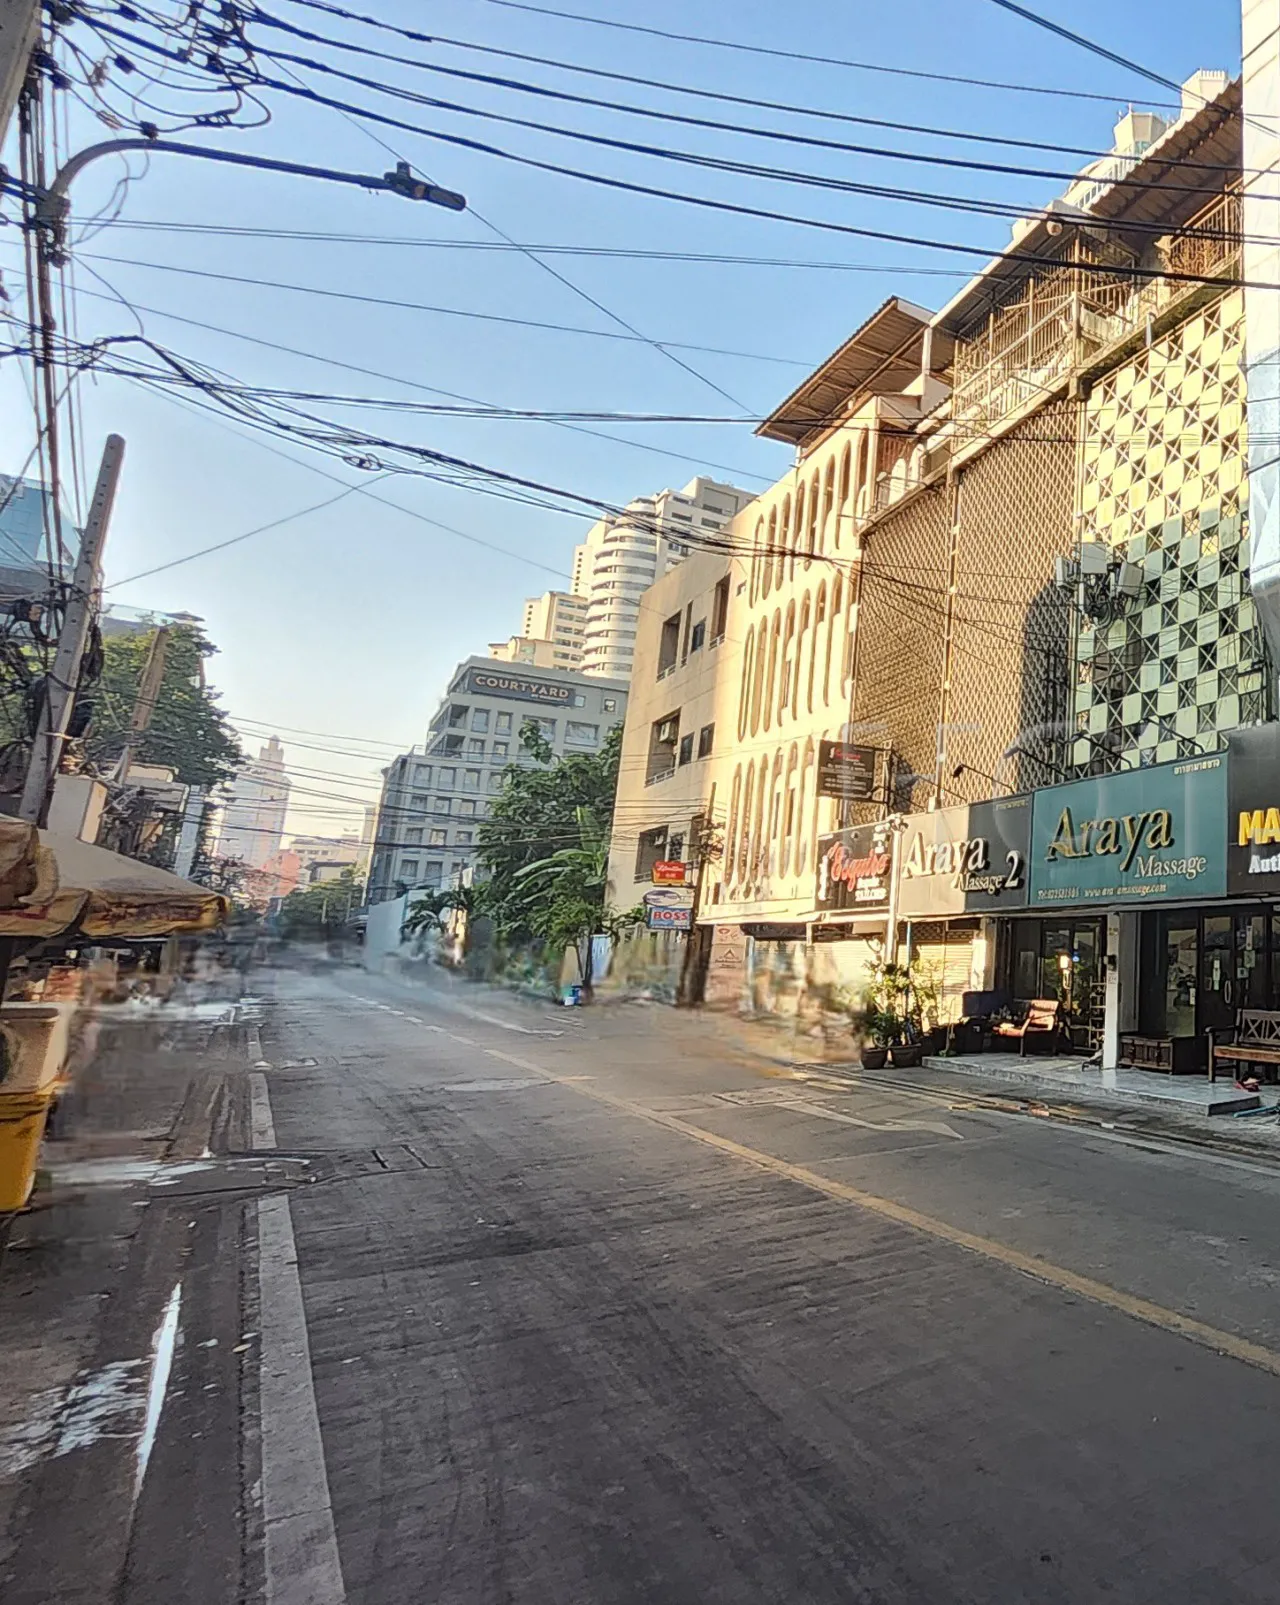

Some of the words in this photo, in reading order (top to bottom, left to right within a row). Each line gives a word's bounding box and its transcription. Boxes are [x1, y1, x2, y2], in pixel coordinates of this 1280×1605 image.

[475, 675, 569, 698] COURTYARD
[1045, 806, 1174, 872] Araya
[902, 831, 988, 889] Araya
[1004, 849, 1022, 888] 2
[1134, 855, 1207, 879] Massage
[653, 911, 689, 921] BOSS
